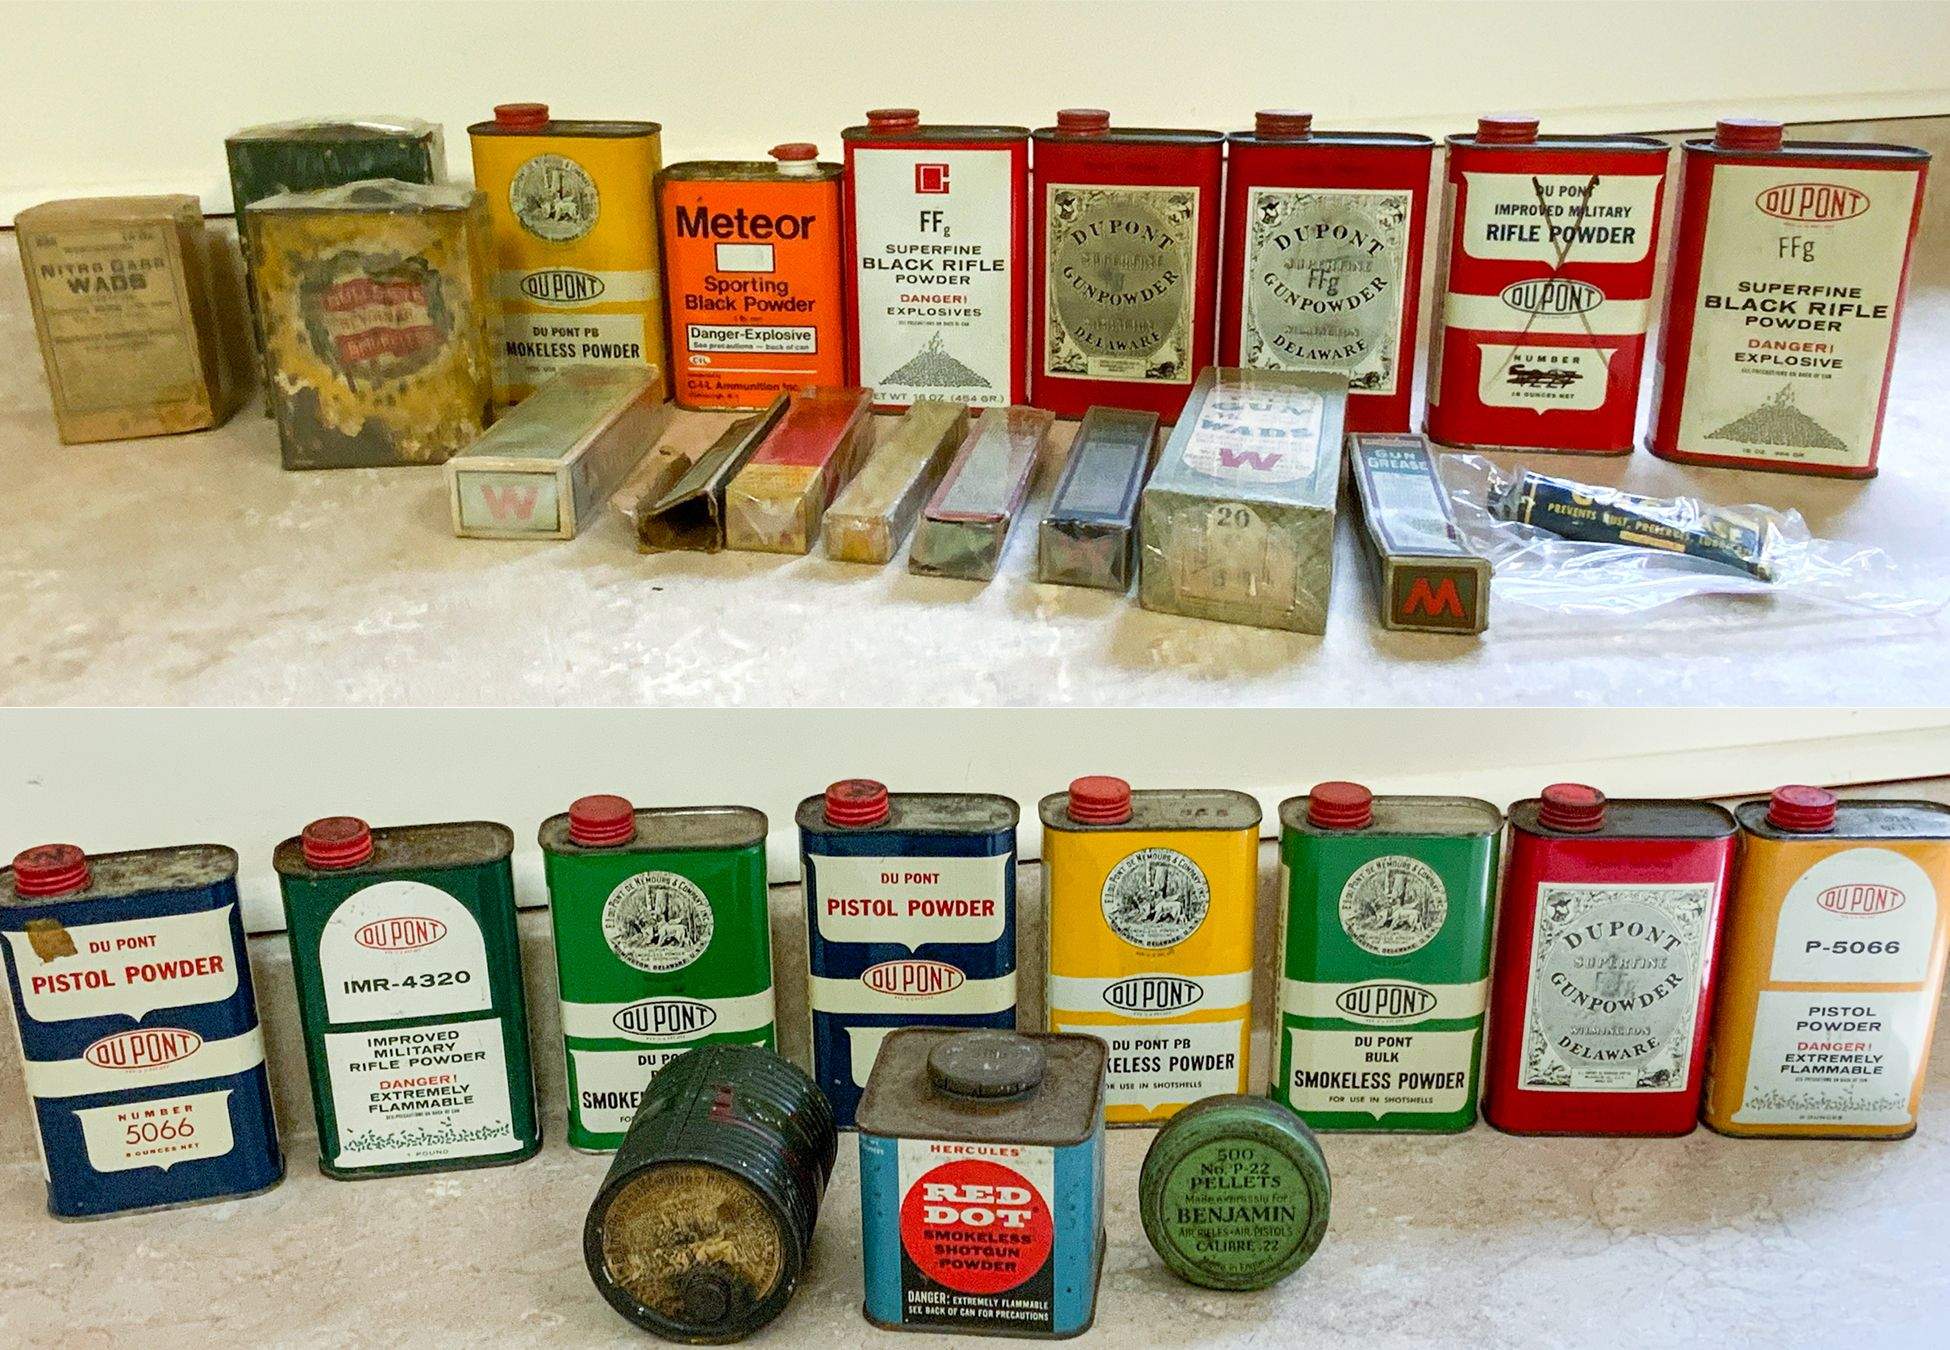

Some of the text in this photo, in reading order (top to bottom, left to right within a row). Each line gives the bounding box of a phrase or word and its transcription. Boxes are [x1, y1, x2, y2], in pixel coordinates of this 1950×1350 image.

[1537, 185, 1594, 197] DU PONT
[1495, 204, 1631, 218] IMPROVED MILITARY
[676, 205, 815, 239] Meteor
[1071, 220, 1175, 250] DUPONT
[1273, 223, 1385, 256] DUPONT
[1487, 225, 1635, 244] RIFLE POWDER
[886, 244, 982, 255] SUPERFINE
[1779, 236, 1815, 263] FFg
[863, 257, 1004, 271] BLACK RIFLE
[68, 273, 146, 293] WADS
[705, 275, 789, 296] Sporting
[896, 275, 970, 285] POWDER
[1063, 266, 1180, 306] GUNPOWDER
[1264, 272, 1388, 314] GUNPOWDER
[1738, 281, 1862, 299] SUPERFINE
[686, 294, 815, 312] Black Powder
[900, 294, 967, 304] DANGER!
[1705, 295, 1889, 319] BLACK RIFLE
[887, 307, 982, 317] EXPLOSIVES
[533, 327, 599, 337] DU PONT PB
[1746, 316, 1842, 333] POWDER
[1074, 326, 1162, 350] DELAWARE
[1748, 339, 1834, 354] DANGER!
[506, 341, 640, 358] MOKELESS POWDER
[709, 343, 753, 351] precautions
[1273, 334, 1368, 360] DELAWARE
[1514, 354, 1580, 364] NUMBER
[1734, 352, 1843, 369] EXPLOSIVE
[716, 381, 780, 391] Ammunition
[1219, 448, 1283, 471] W
[1375, 449, 1416, 459] GUN
[1368, 457, 1429, 471] GREASE
[480, 485, 539, 520] W
[1217, 506, 1250, 529] 20
[1547, 503, 1597, 521] PREVENTS
[881, 873, 940, 884] DU PONT
[827, 899, 995, 916] PISTOL POWDER
[89, 935, 157, 953] DU PONT
[1563, 921, 1682, 953] DUPONT
[1805, 940, 1900, 954] P-5066
[31, 955, 224, 994] PISTOL POWDER
[344, 970, 471, 994] IMR-4320
[1551, 971, 1684, 1014] GUNPOWDER
[1808, 1006, 1876, 1017] PISTOL
[1796, 1021, 1882, 1032] POWDER
[367, 1030, 460, 1048] IMPROVED
[1113, 1039, 1191, 1050] DU PONT PB
[1355, 1036, 1412, 1047] DU PONT
[1797, 1042, 1872, 1051] DANGER!
[374, 1042, 456, 1059] MILITARY
[1558, 1036, 1660, 1061] DELAWARE
[349, 1051, 486, 1073] RIFLE POWDER
[638, 1054, 680, 1065] DU PO
[1106, 1053, 1235, 1074] KELESS POWDER
[1365, 1052, 1399, 1063] BULK
[1785, 1053, 1884, 1064] EXTREMELY
[1780, 1065, 1884, 1075] FLAMMABLE
[379, 1074, 458, 1090] DANGER!
[1119, 1082, 1135, 1090] USE
[1153, 1081, 1202, 1089] SHOTSHELLS
[1294, 1070, 1465, 1089] SMOKELESS POWDER
[370, 1084, 471, 1102] EXTREMELY
[583, 1091, 645, 1109] SMOKE
[1384, 1096, 1433, 1104] SHOTSHELLS
[118, 1104, 194, 1122] NUMBER
[368, 1095, 475, 1114] FLAMMABLE
[126, 1117, 195, 1144] 5066
[132, 1146, 178, 1157] OUNCES
[930, 1145, 1020, 1157] HERCULES
[1218, 1149, 1253, 1161] 500
[1190, 1175, 1281, 1190] PELLETS
[923, 1183, 1032, 1205] RED
[923, 1205, 1032, 1228] DOT
[1177, 1206, 1295, 1224] BENJAMIN
[923, 1230, 1033, 1244] SMOKELESS
[934, 1244, 1020, 1258] SHOTGUN
[1196, 1240, 1254, 1252] CALIBRE
[939, 1259, 1018, 1272] POWDER
[907, 1290, 1048, 1310] DANGER: EXTREMELY FLAMMABLE
[908, 1306, 1049, 1322] SEE BACK OF CAN FOR PRECAUTIONS
